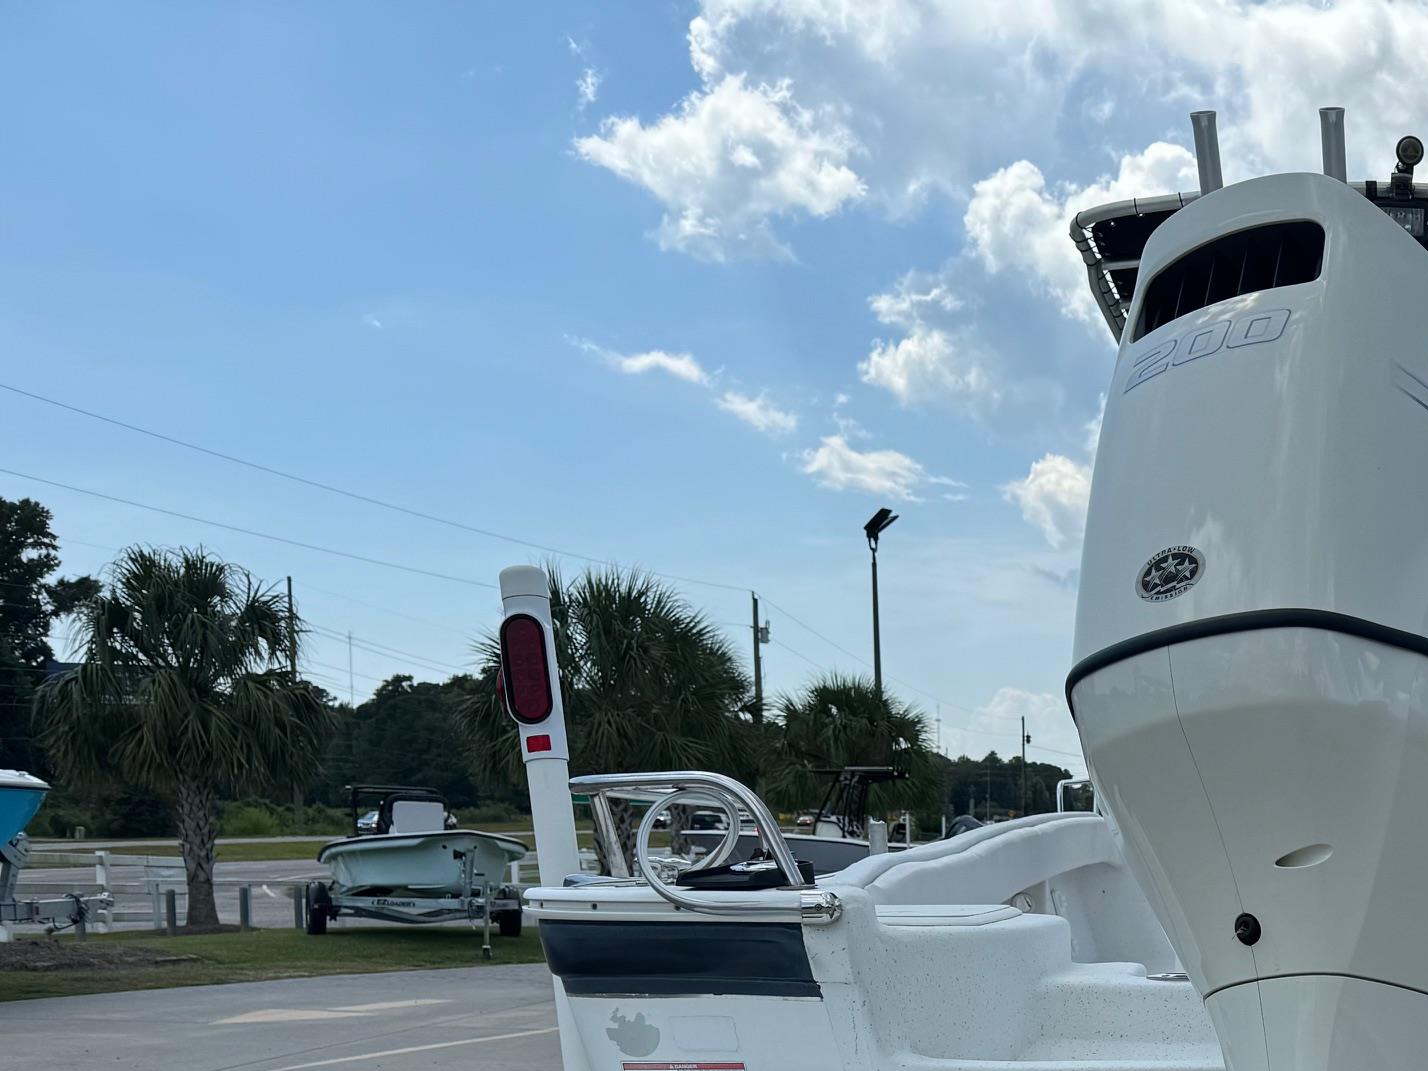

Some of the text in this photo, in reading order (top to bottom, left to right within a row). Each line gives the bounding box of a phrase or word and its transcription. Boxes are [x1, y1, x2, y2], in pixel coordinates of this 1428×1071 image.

[1123, 308, 1292, 395] 200
[1146, 545, 1196, 566] ULTRA LOW
